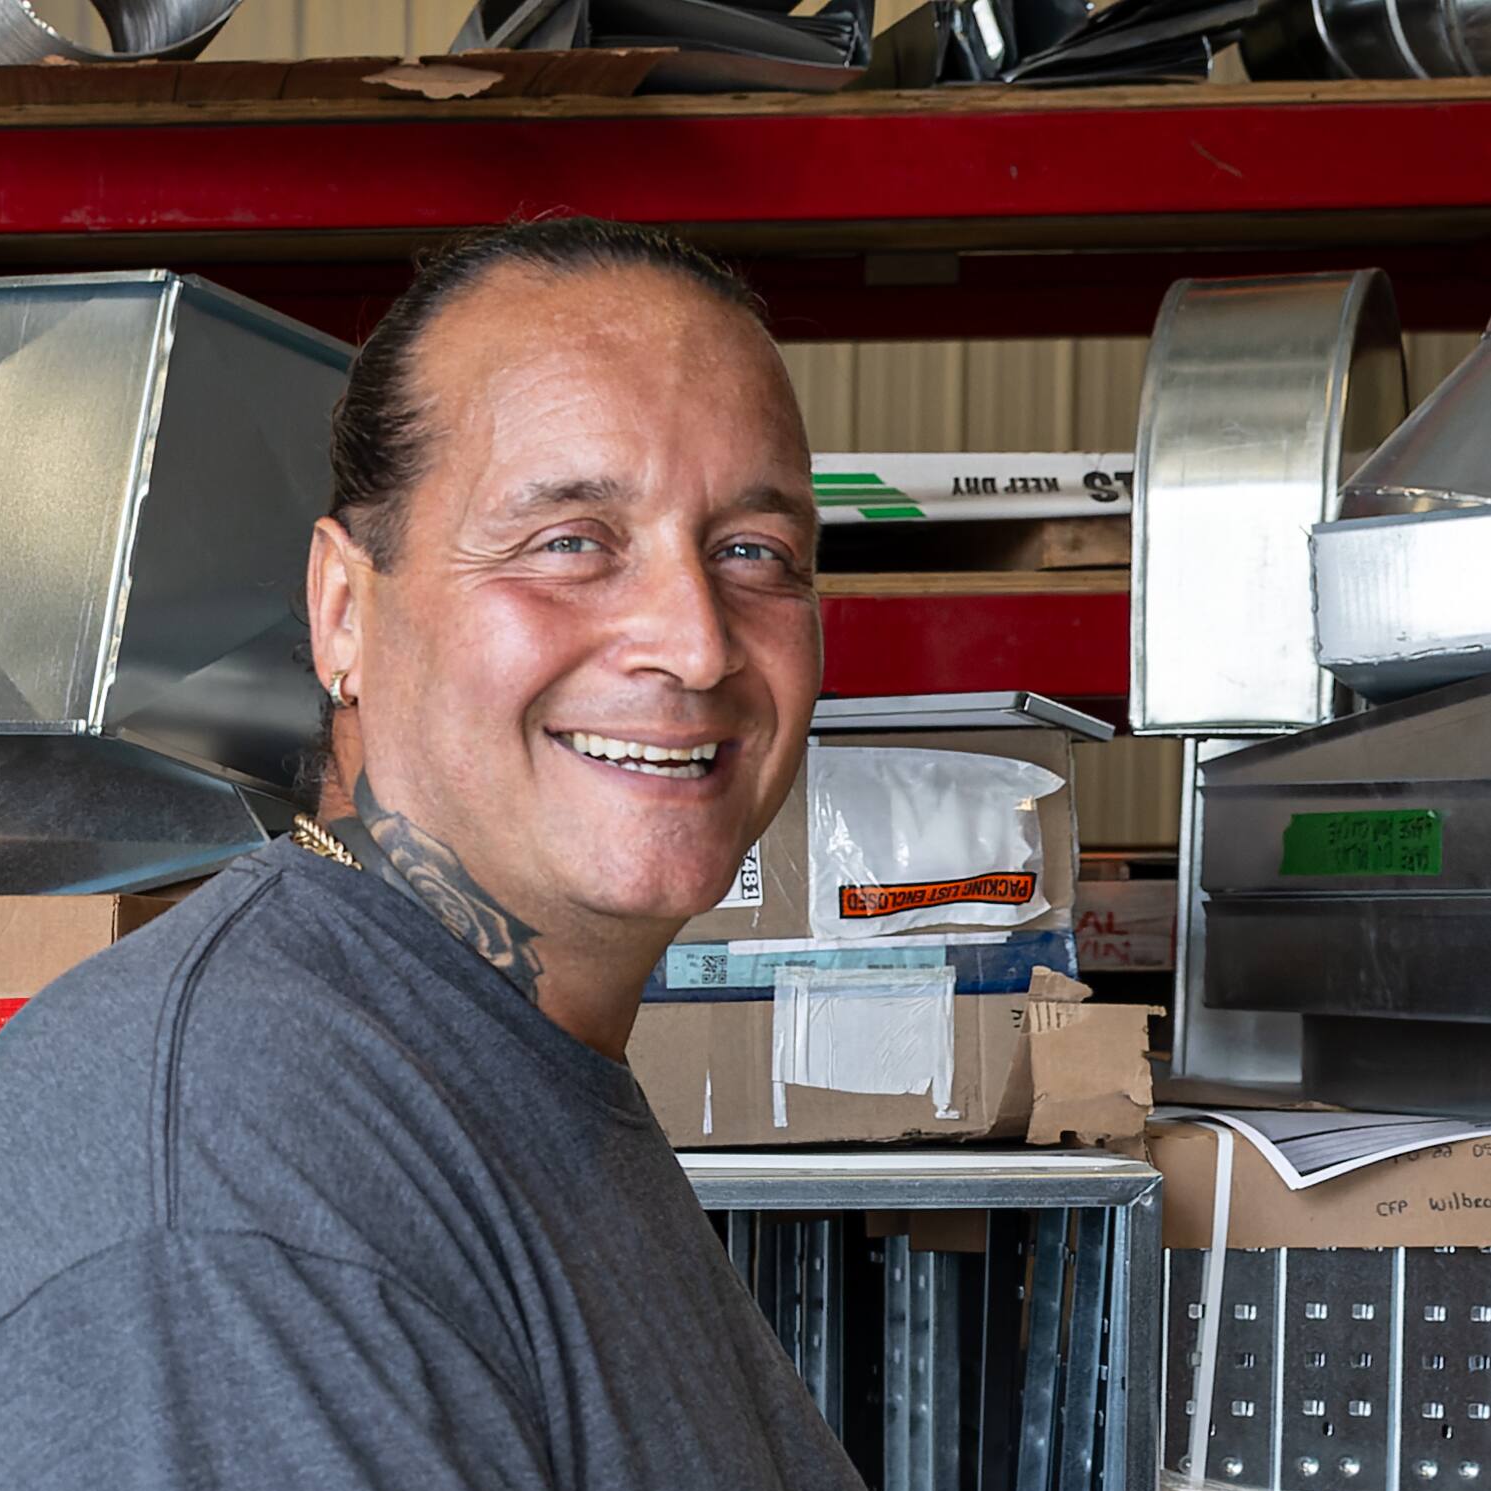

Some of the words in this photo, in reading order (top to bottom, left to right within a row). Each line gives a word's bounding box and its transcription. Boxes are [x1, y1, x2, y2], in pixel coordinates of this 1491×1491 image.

[952, 477, 997, 496] DRY
[1004, 477, 1060, 494] KEEP
[930, 885, 960, 900] LIST
[966, 879, 1029, 897] PACKING
[848, 889, 926, 910] ENCLOSED
[1376, 1200, 1408, 1216] CFP
